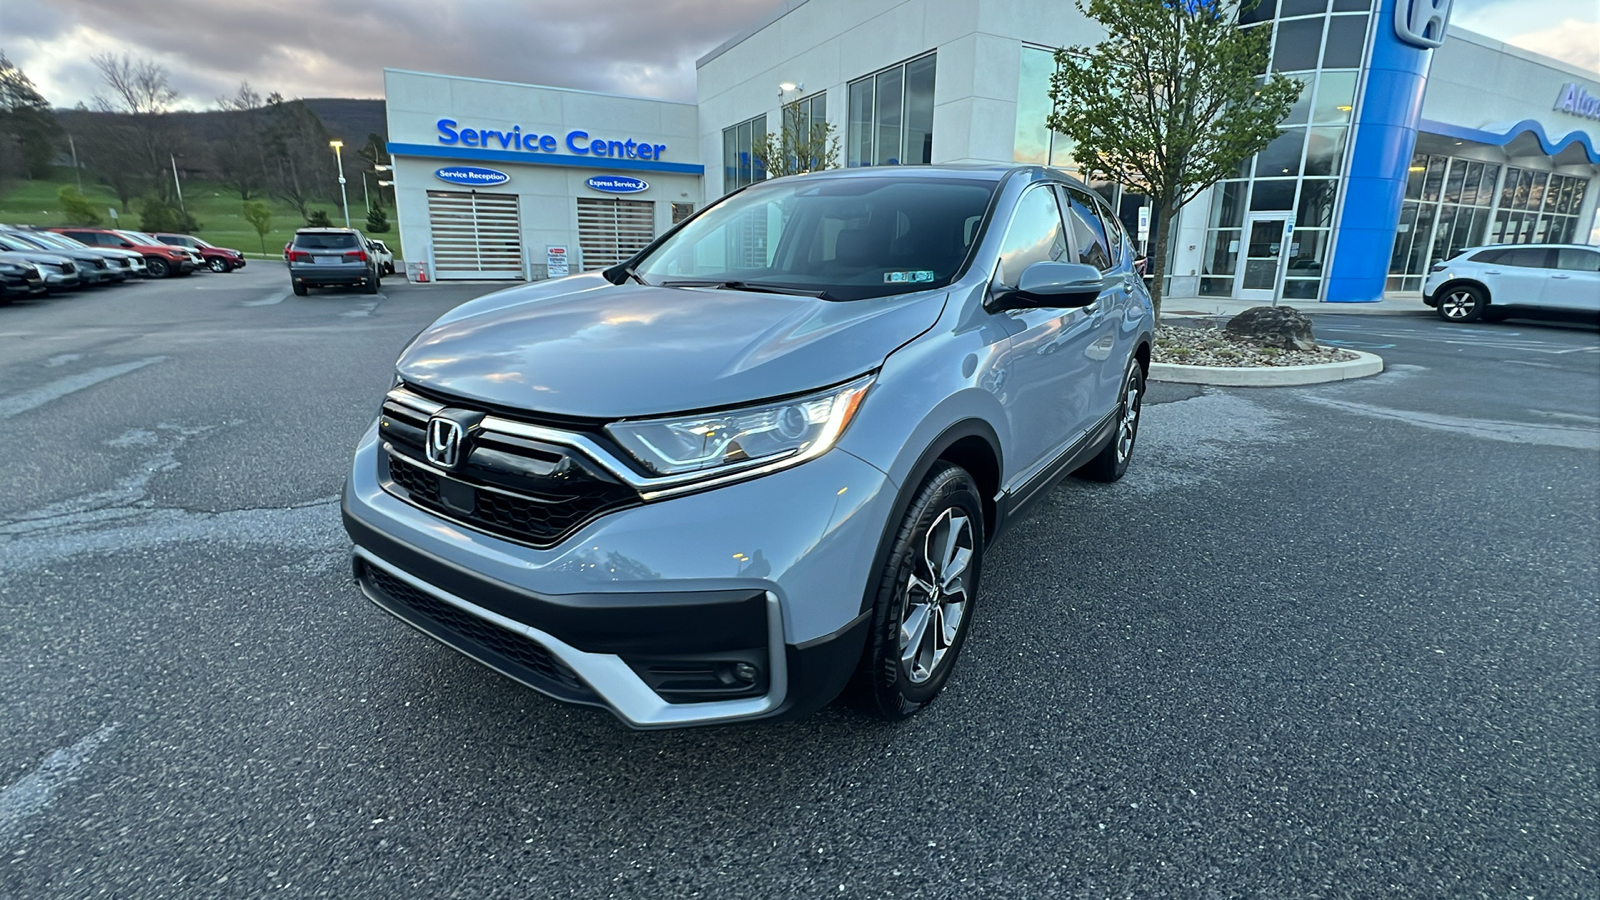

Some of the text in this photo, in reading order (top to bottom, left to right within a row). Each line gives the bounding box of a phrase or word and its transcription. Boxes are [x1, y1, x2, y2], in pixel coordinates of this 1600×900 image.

[437, 118, 666, 160] Service Center
[439, 169, 505, 181] Service Reception
[589, 179, 636, 189] Express Service
[888, 546, 914, 640] NEXEN
